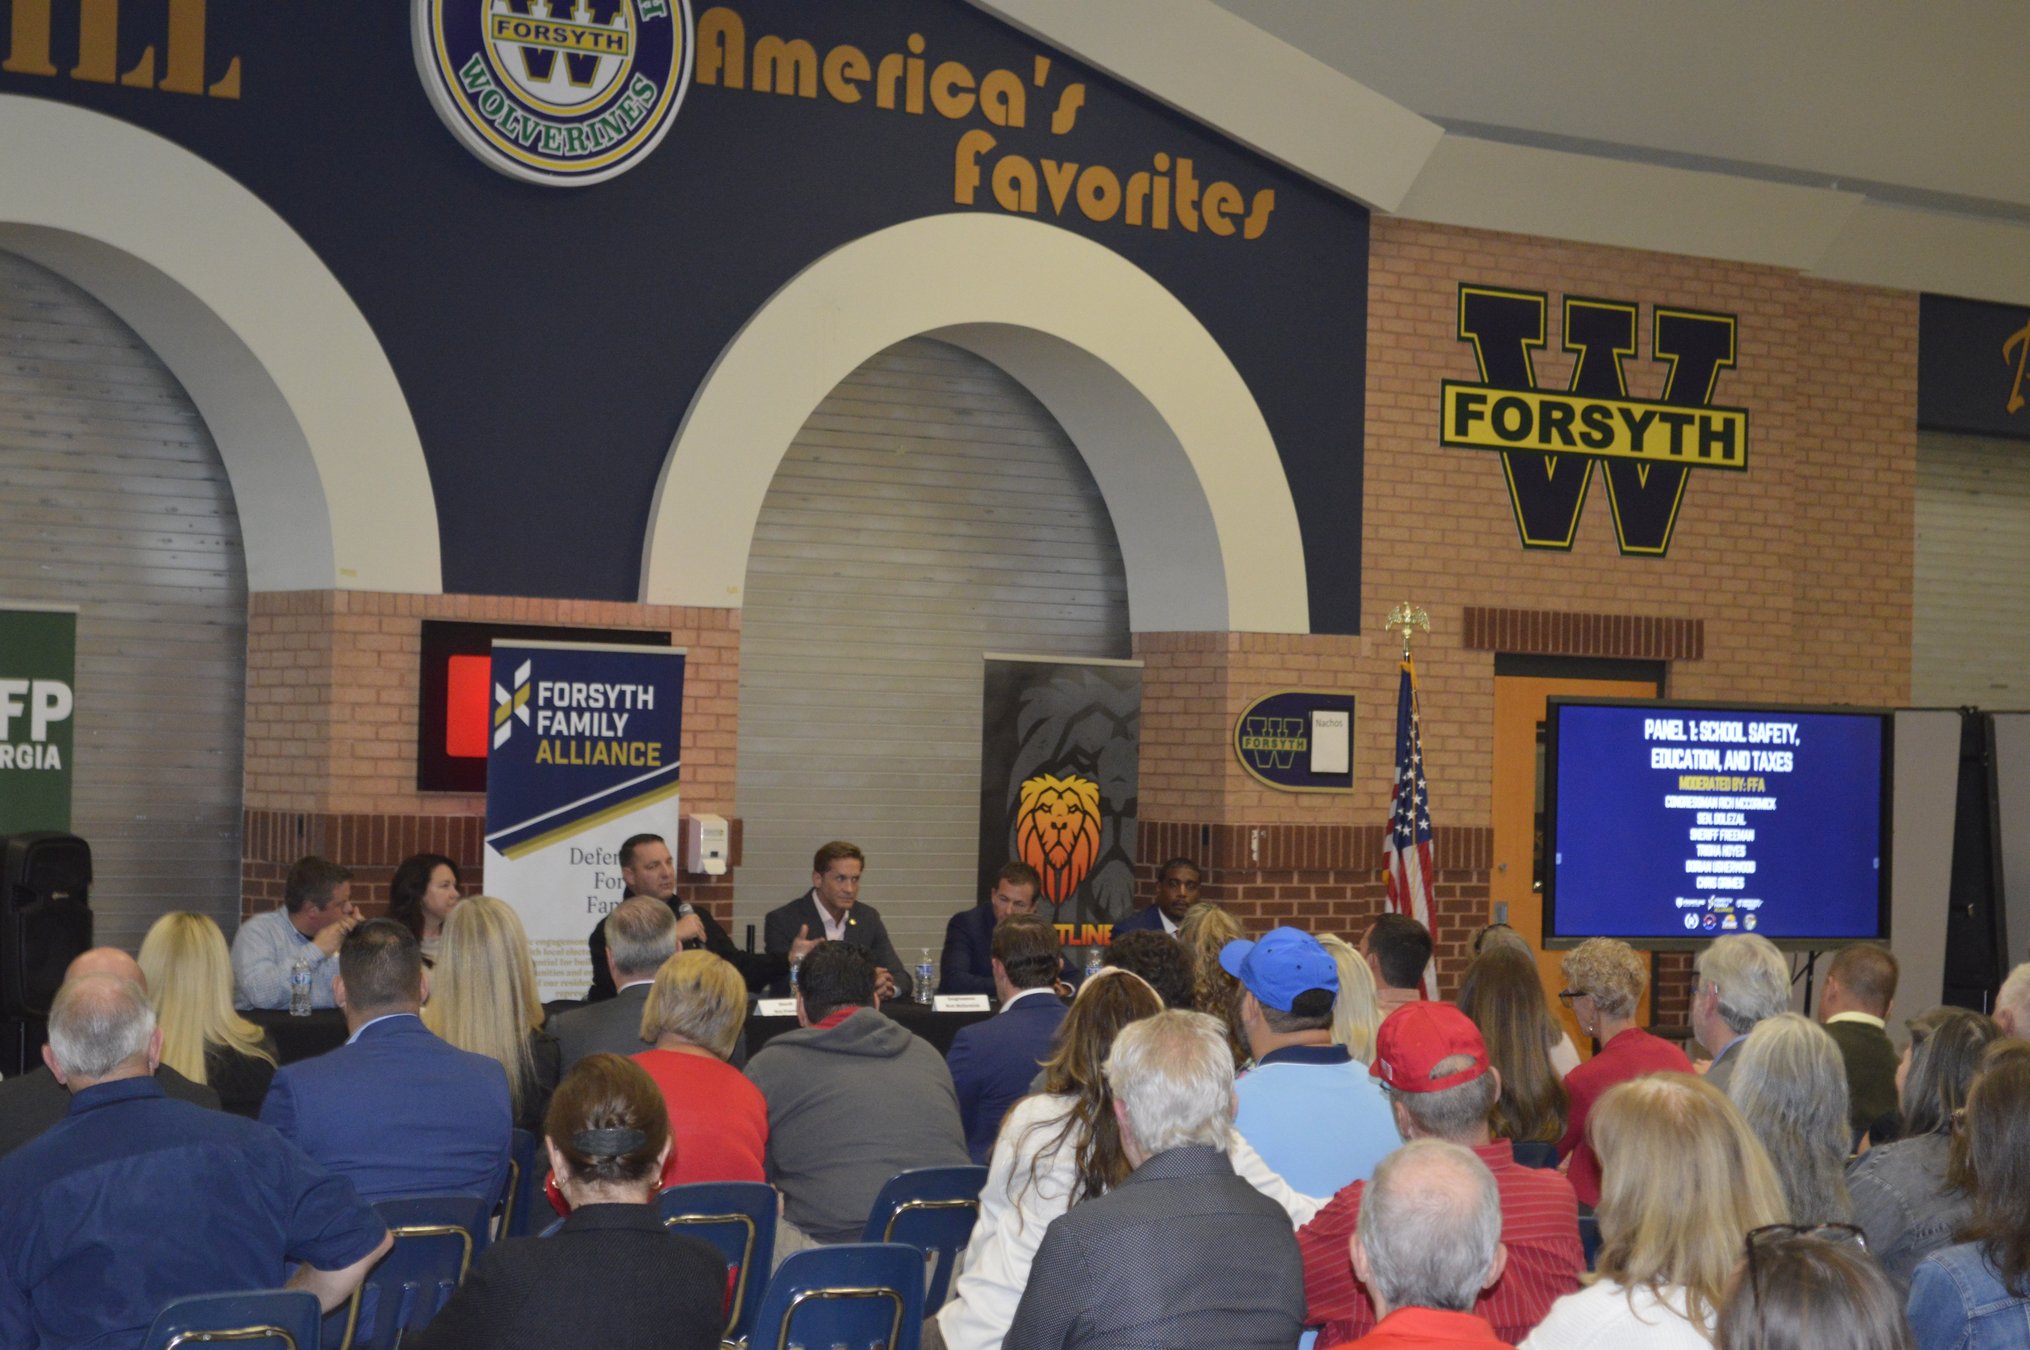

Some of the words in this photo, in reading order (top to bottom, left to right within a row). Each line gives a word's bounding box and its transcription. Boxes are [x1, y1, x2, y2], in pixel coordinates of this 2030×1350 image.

[496, 20, 624, 51] FORSYTH
[695, 6, 1086, 136] America's
[459, 53, 657, 156] WOLVERINES
[1454, 391, 1737, 461] FORSYTH
[537, 681, 655, 710] FORSYTH
[536, 710, 629, 738] FAMILY
[1315, 719, 1343, 728] Nachos
[1644, 719, 1687, 741] PANEL
[1699, 720, 1747, 742] SCHOOL
[1748, 722, 1800, 746] SAFETY,
[535, 739, 662, 767] ALLIANCE
[1244, 737, 1304, 750] FORSYTH
[1651, 747, 1722, 772] EDUCATION,
[1724, 750, 1750, 771] AND
[1752, 750, 1793, 772] TAXES
[1679, 775, 1731, 791] MODERATED
[1747, 777, 1766, 792] FFA
[1053, 923, 1115, 945] TLINE
